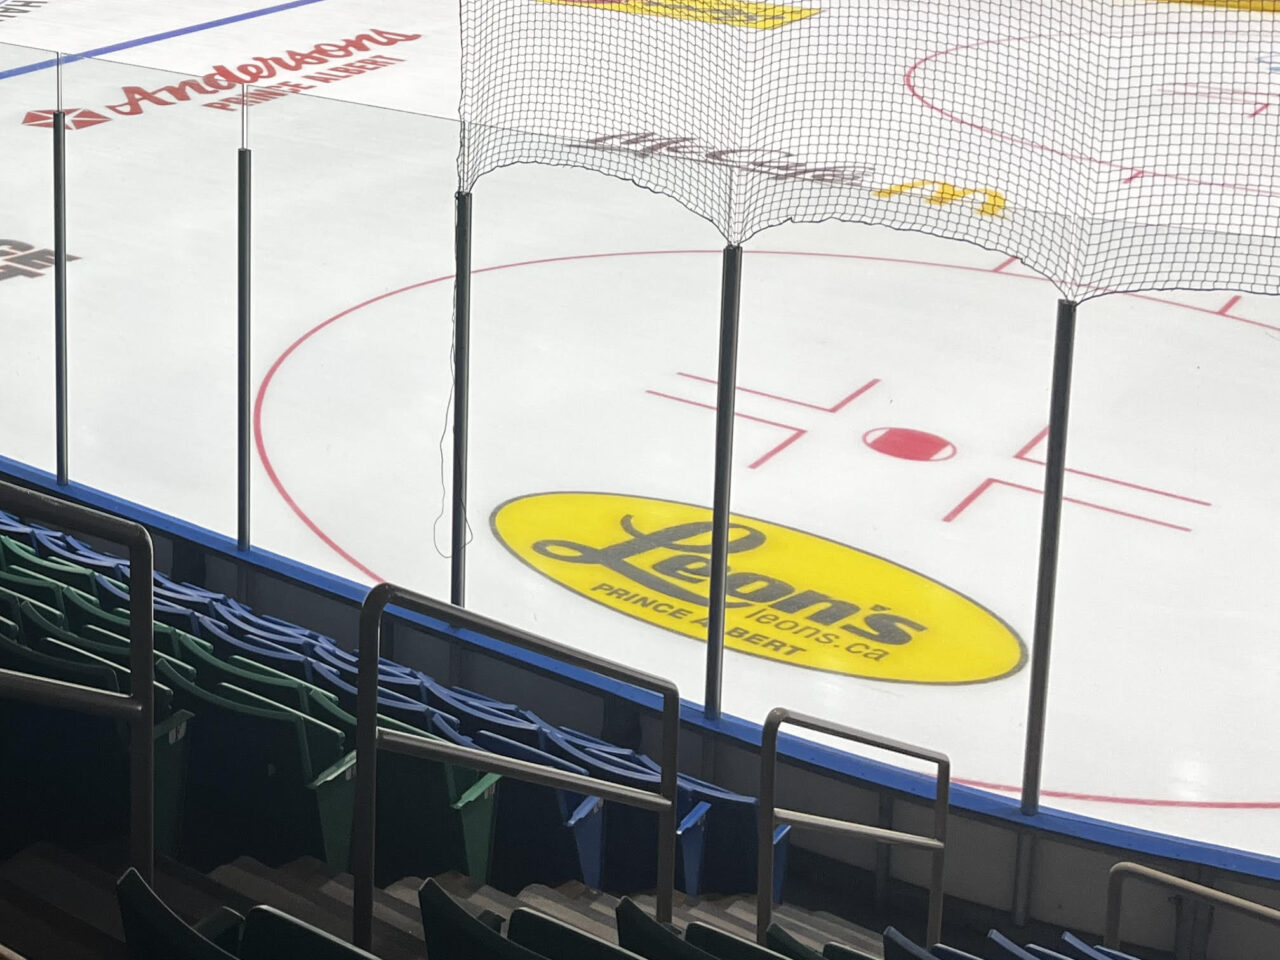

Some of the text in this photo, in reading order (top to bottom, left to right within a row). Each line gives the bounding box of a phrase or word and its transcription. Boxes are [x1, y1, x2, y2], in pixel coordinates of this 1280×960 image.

[106, 29, 421, 115] Andersons
[202, 55, 407, 111] PRINCE ALBERT
[531, 513, 928, 646] Leon's
[590, 582, 807, 657] PRINCE ABERT
[745, 607, 891, 663] leons.ca
